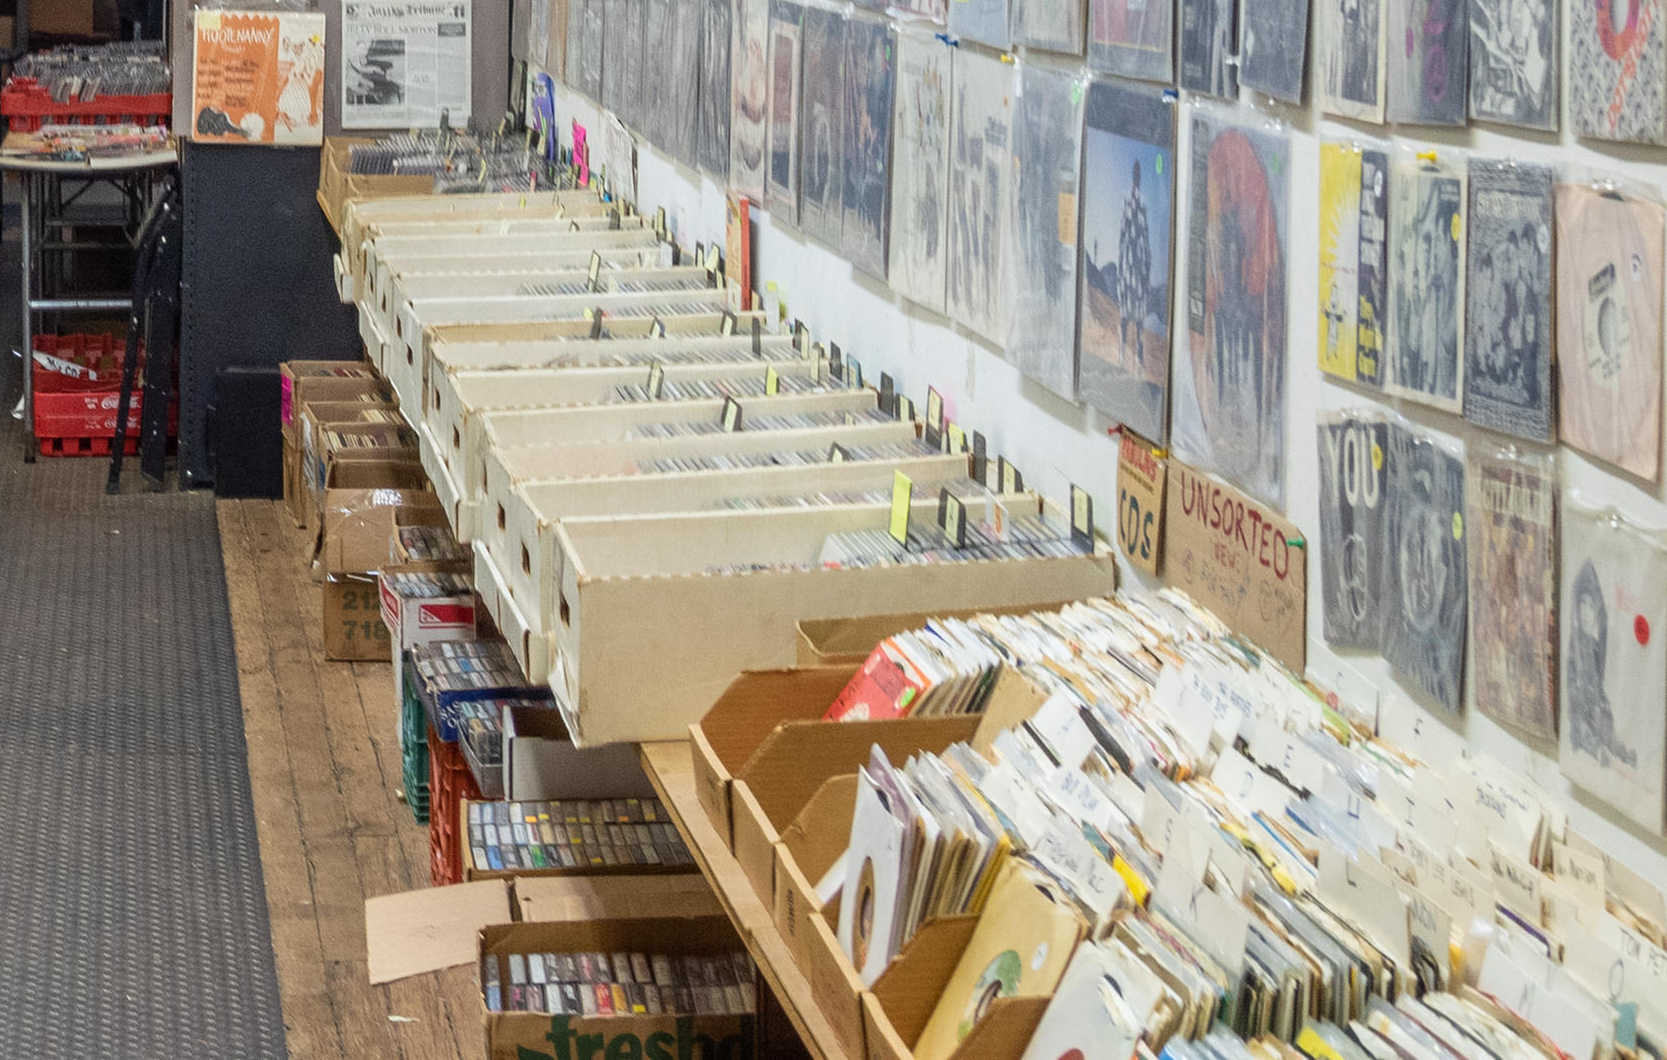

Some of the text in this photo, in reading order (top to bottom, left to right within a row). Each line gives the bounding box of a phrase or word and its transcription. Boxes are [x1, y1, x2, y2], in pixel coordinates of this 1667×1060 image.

[1325, 427, 1380, 509] YOU
[1119, 488, 1154, 561] CDS
[1181, 470, 1289, 580] UNSORTED
